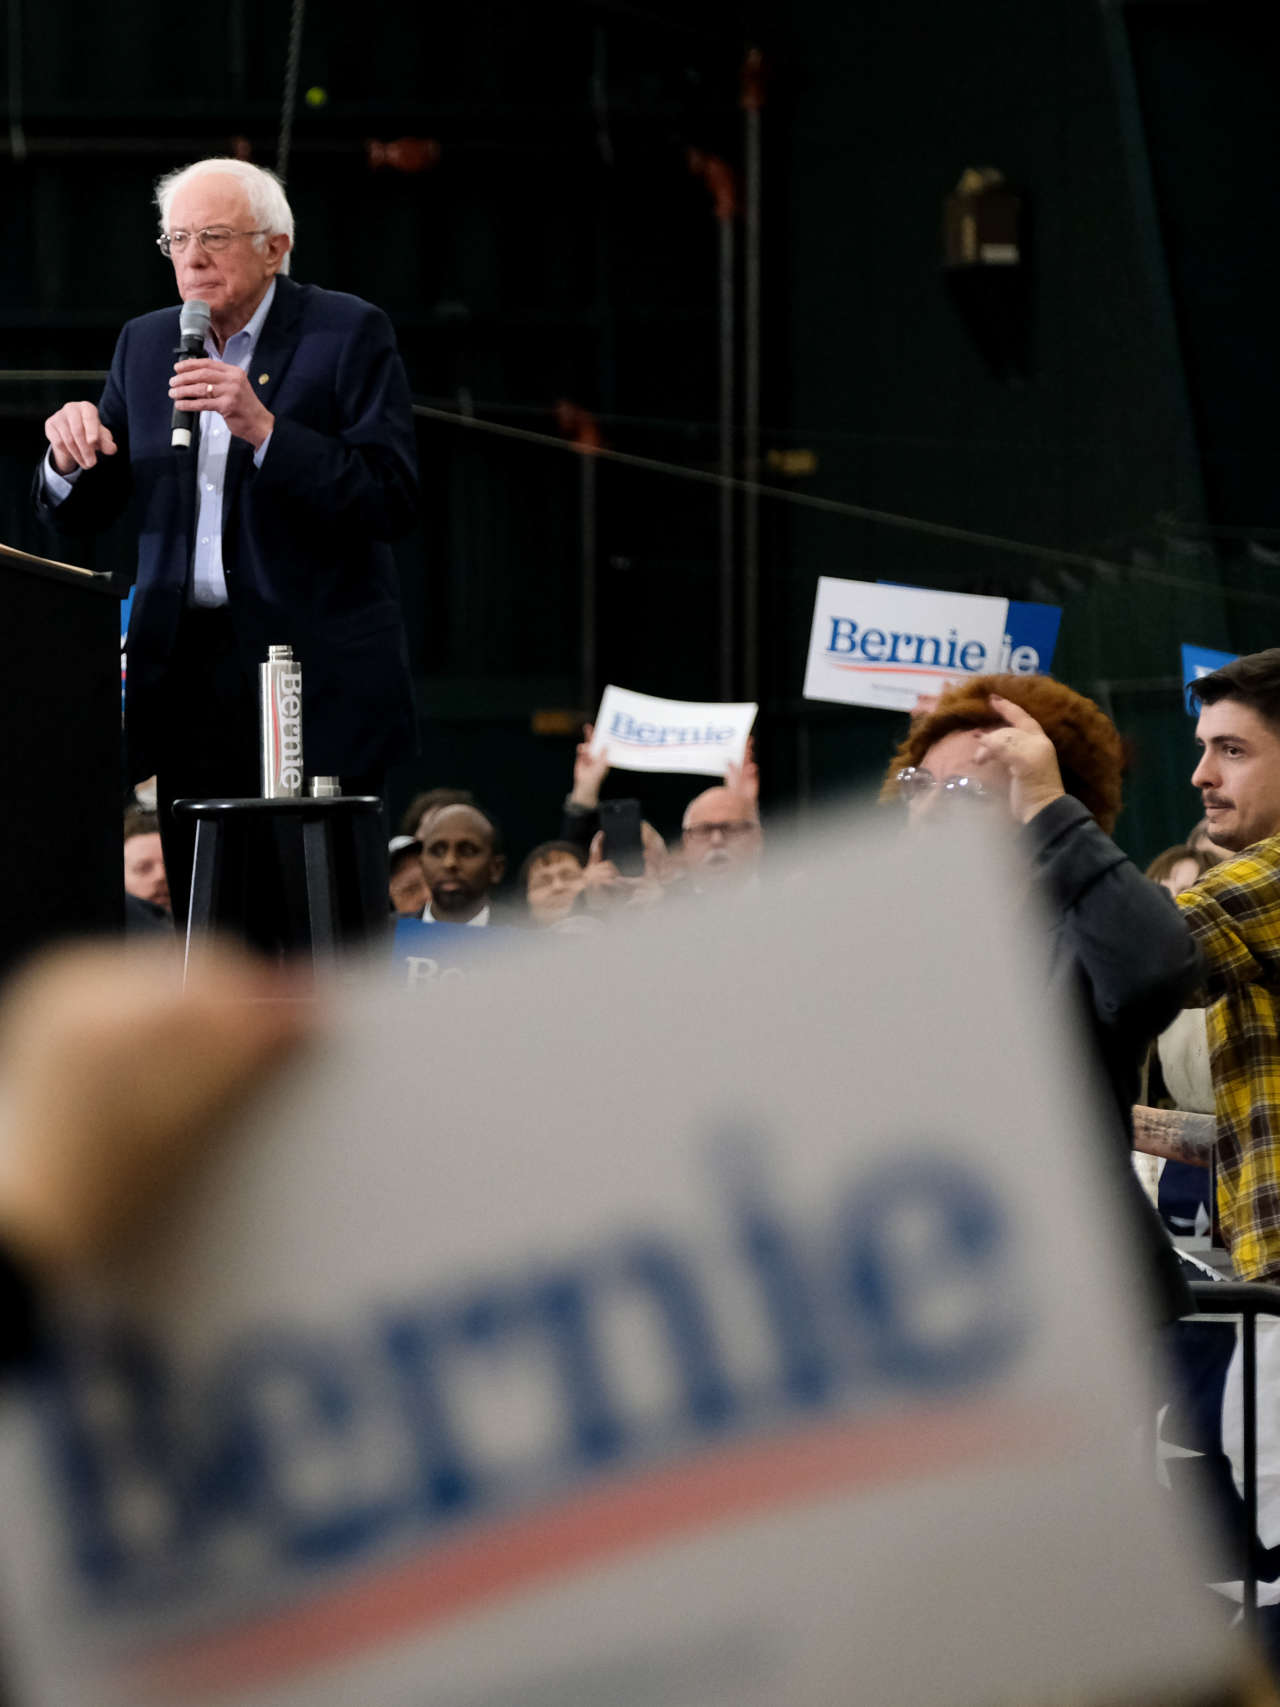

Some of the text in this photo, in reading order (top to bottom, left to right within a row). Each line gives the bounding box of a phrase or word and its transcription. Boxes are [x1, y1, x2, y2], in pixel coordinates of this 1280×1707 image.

[827, 614, 987, 673] Bernie
[280, 671, 303, 790] Bernie
[610, 710, 736, 745] Bernie
[38, 1105, 1032, 1612] Bernie
